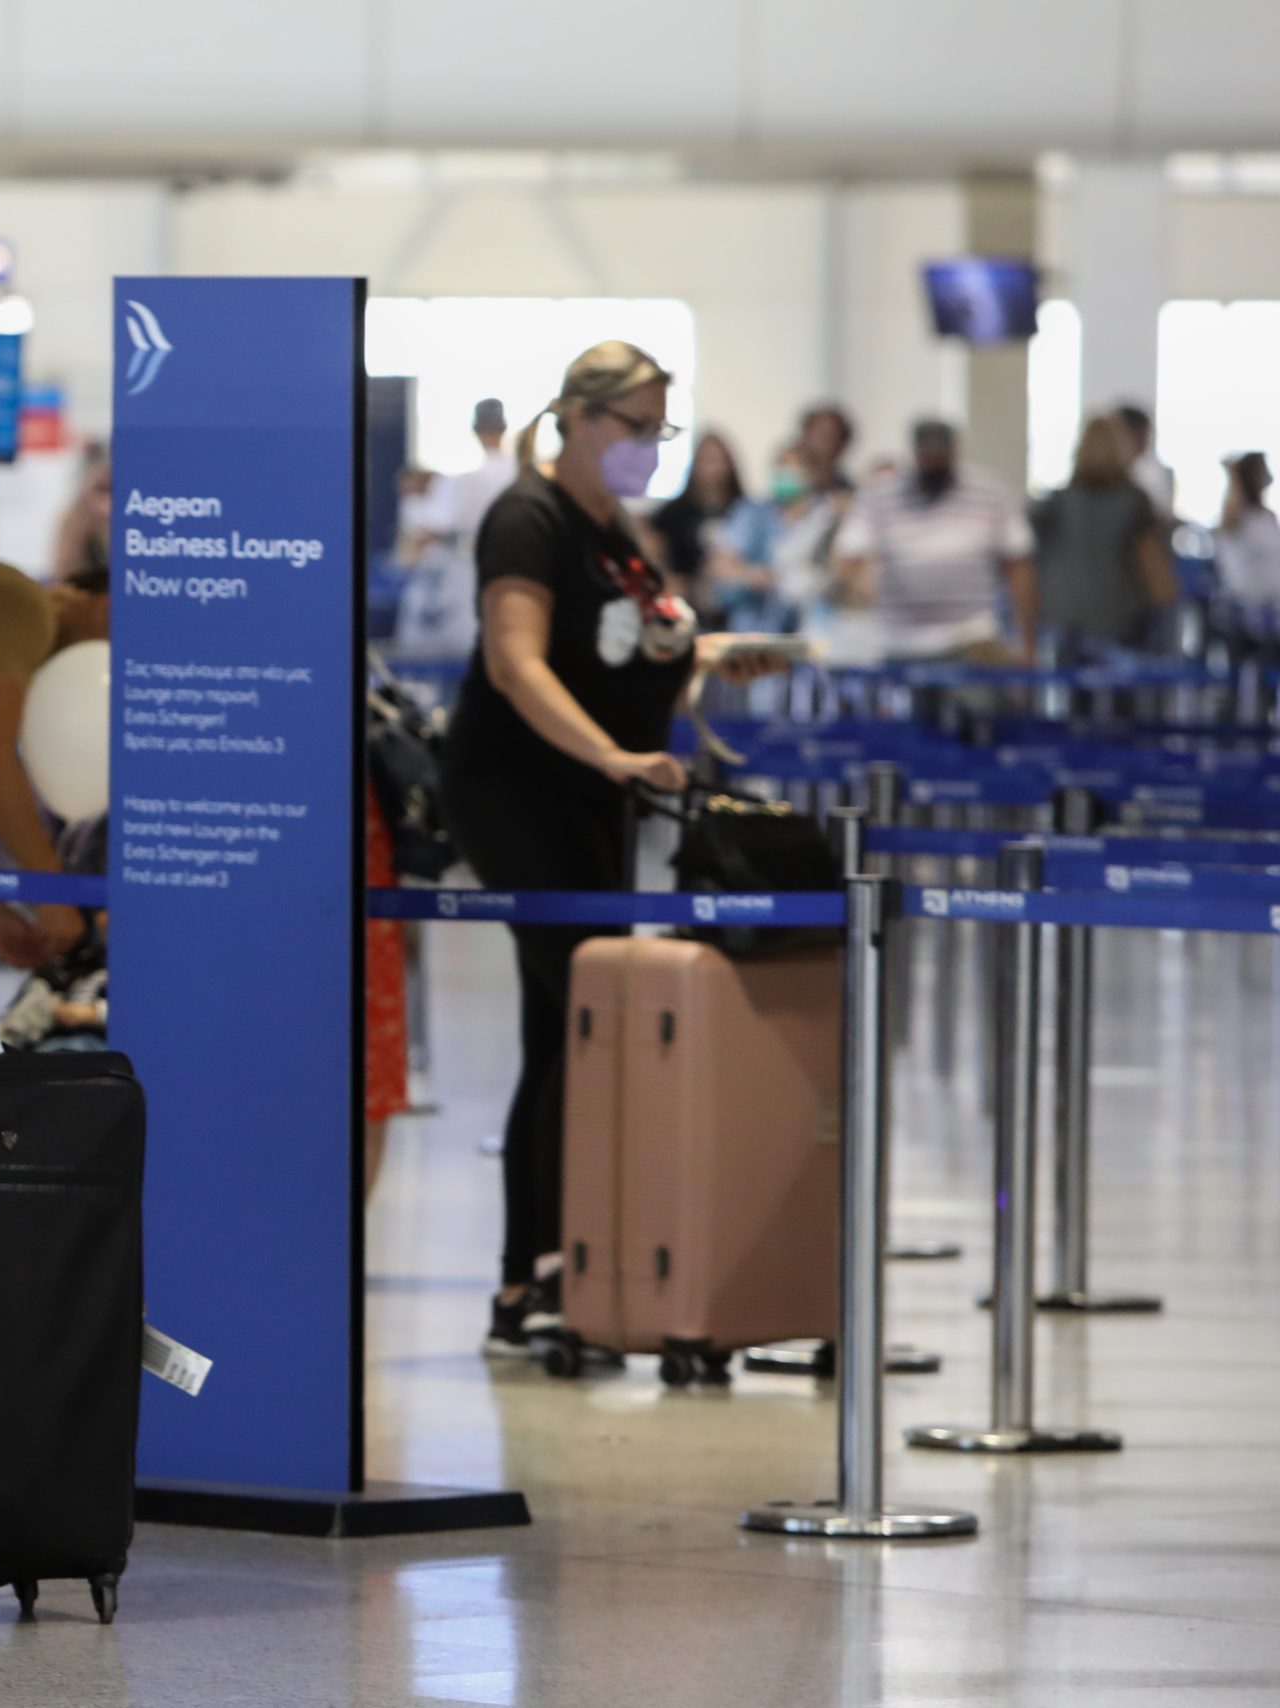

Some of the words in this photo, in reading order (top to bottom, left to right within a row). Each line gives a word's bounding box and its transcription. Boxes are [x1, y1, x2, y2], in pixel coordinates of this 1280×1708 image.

[125, 489, 221, 524] Aegean
[125, 529, 227, 559] Business
[231, 531, 323, 567] Lounge
[125, 569, 182, 597] Now
[185, 576, 247, 604] open
[123, 796, 166, 816] Happy
[184, 799, 242, 815] welcome
[244, 803, 269, 819] you
[286, 804, 306, 818] our
[164, 823, 193, 837] new
[258, 825, 280, 841] the
[123, 866, 151, 884] Find
[950, 892, 1025, 908] ATHENS
